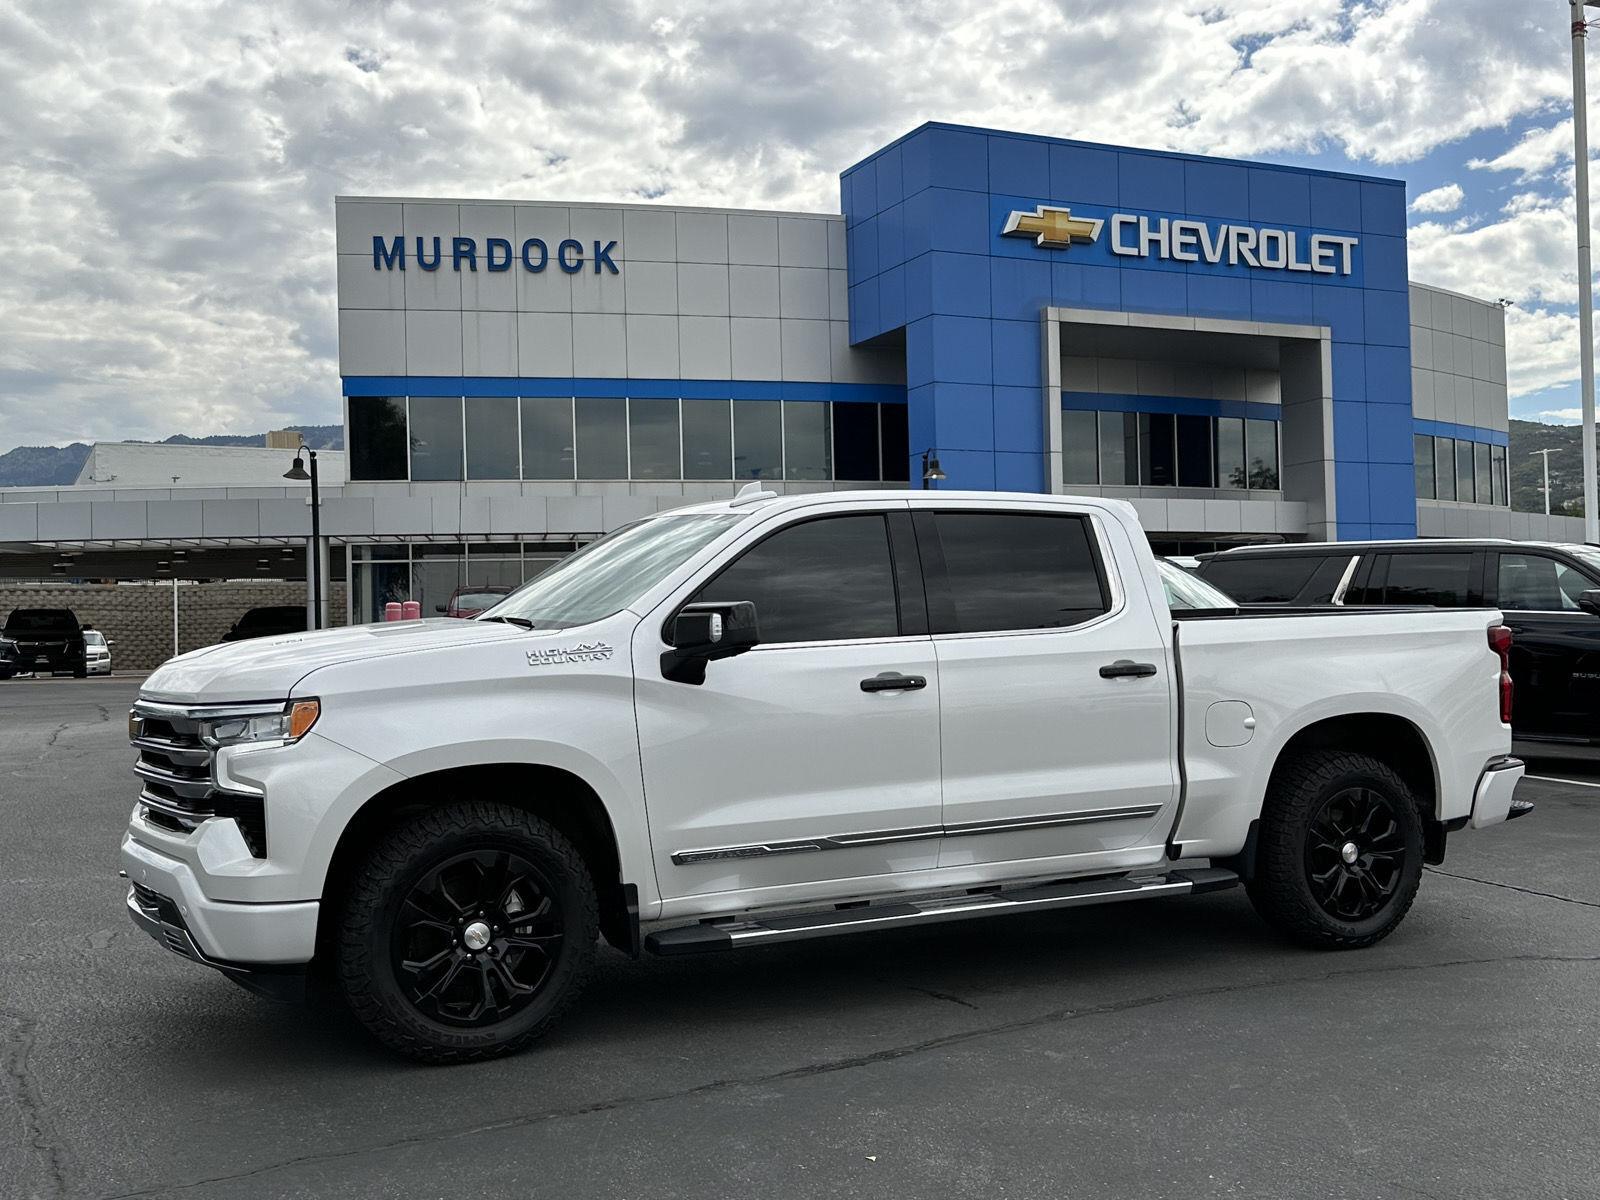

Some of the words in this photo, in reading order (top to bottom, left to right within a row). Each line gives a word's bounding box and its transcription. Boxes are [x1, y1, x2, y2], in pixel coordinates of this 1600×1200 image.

[373, 236, 619, 275] MURDOCK
[1111, 213, 1358, 275] CHEVROLET
[526, 648, 569, 659] HIGH
[528, 652, 613, 666] COUNTRY
